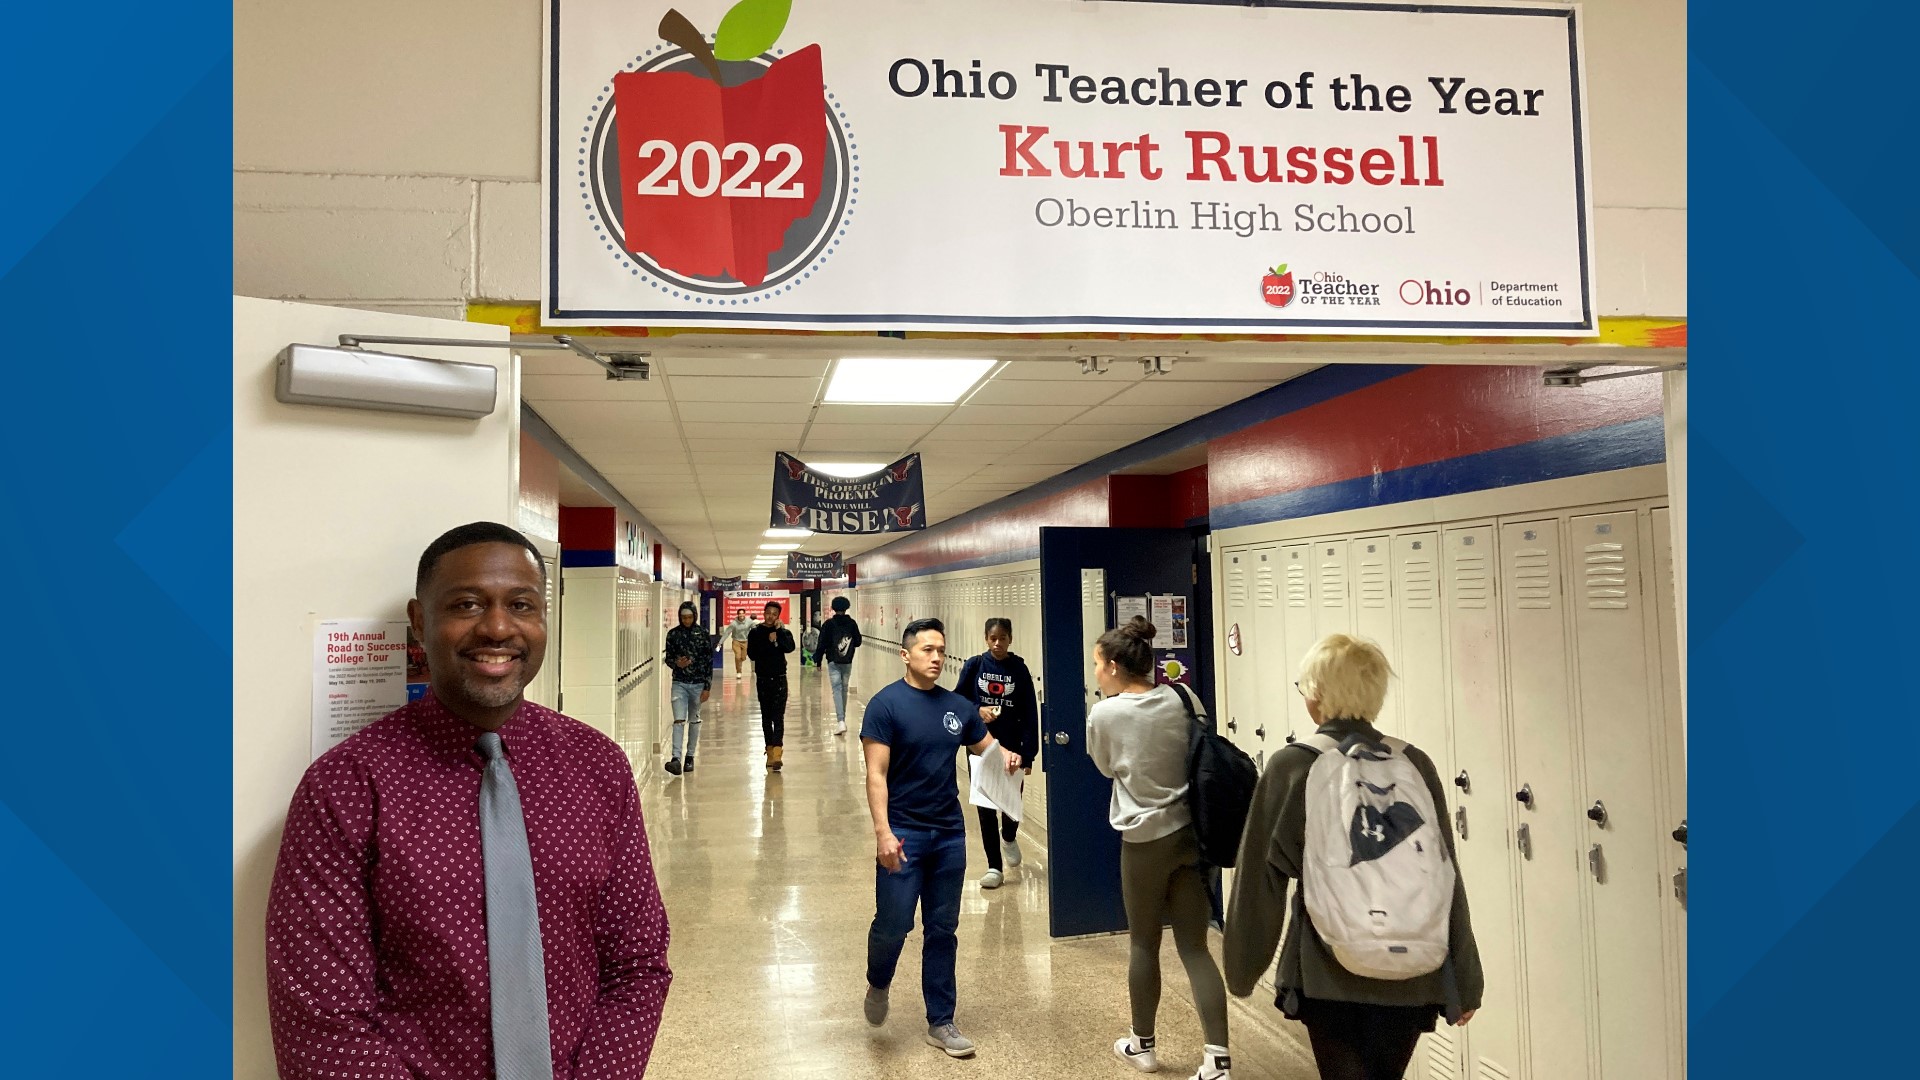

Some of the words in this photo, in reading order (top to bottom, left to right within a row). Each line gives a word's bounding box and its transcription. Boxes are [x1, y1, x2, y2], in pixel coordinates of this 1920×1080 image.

[888, 58, 1018, 100] Ohio
[1035, 63, 1248, 109] Teacher
[1264, 71, 1315, 110] of
[1328, 73, 1412, 112] the
[1427, 76, 1545, 117] Year
[998, 124, 1164, 181] Kurt
[1185, 130, 1445, 187] Russell
[637, 139, 805, 199] 2022
[1035, 197, 1179, 229] Oberlin
[1190, 201, 1283, 238] High
[1294, 203, 1416, 234] School
[1313, 271, 1344, 283] Ohio
[1266, 283, 1292, 296] 2022
[1298, 278, 1380, 298] Teacher
[1399, 279, 1471, 306] Ohio
[1490, 281, 1559, 293] Department
[1300, 296, 1318, 305] OF
[1320, 296, 1346, 306] THE
[1348, 297, 1381, 306] YEAR
[1491, 295, 1503, 306] of
[1506, 296, 1563, 307] Education
[802, 471, 829, 488] THE
[832, 473, 894, 491] OBERLIN
[814, 486, 879, 500] PHOENIX
[849, 502, 871, 510] WILL
[808, 508, 889, 532] RISE!
[328, 632, 349, 642] 19th
[352, 631, 386, 641] Annual
[327, 643, 352, 653] Road
[355, 644, 364, 652] to
[367, 642, 406, 651] Success
[327, 653, 364, 665] College
[367, 653, 389, 662] Tour
[982, 672, 1012, 683] OBERLIN
